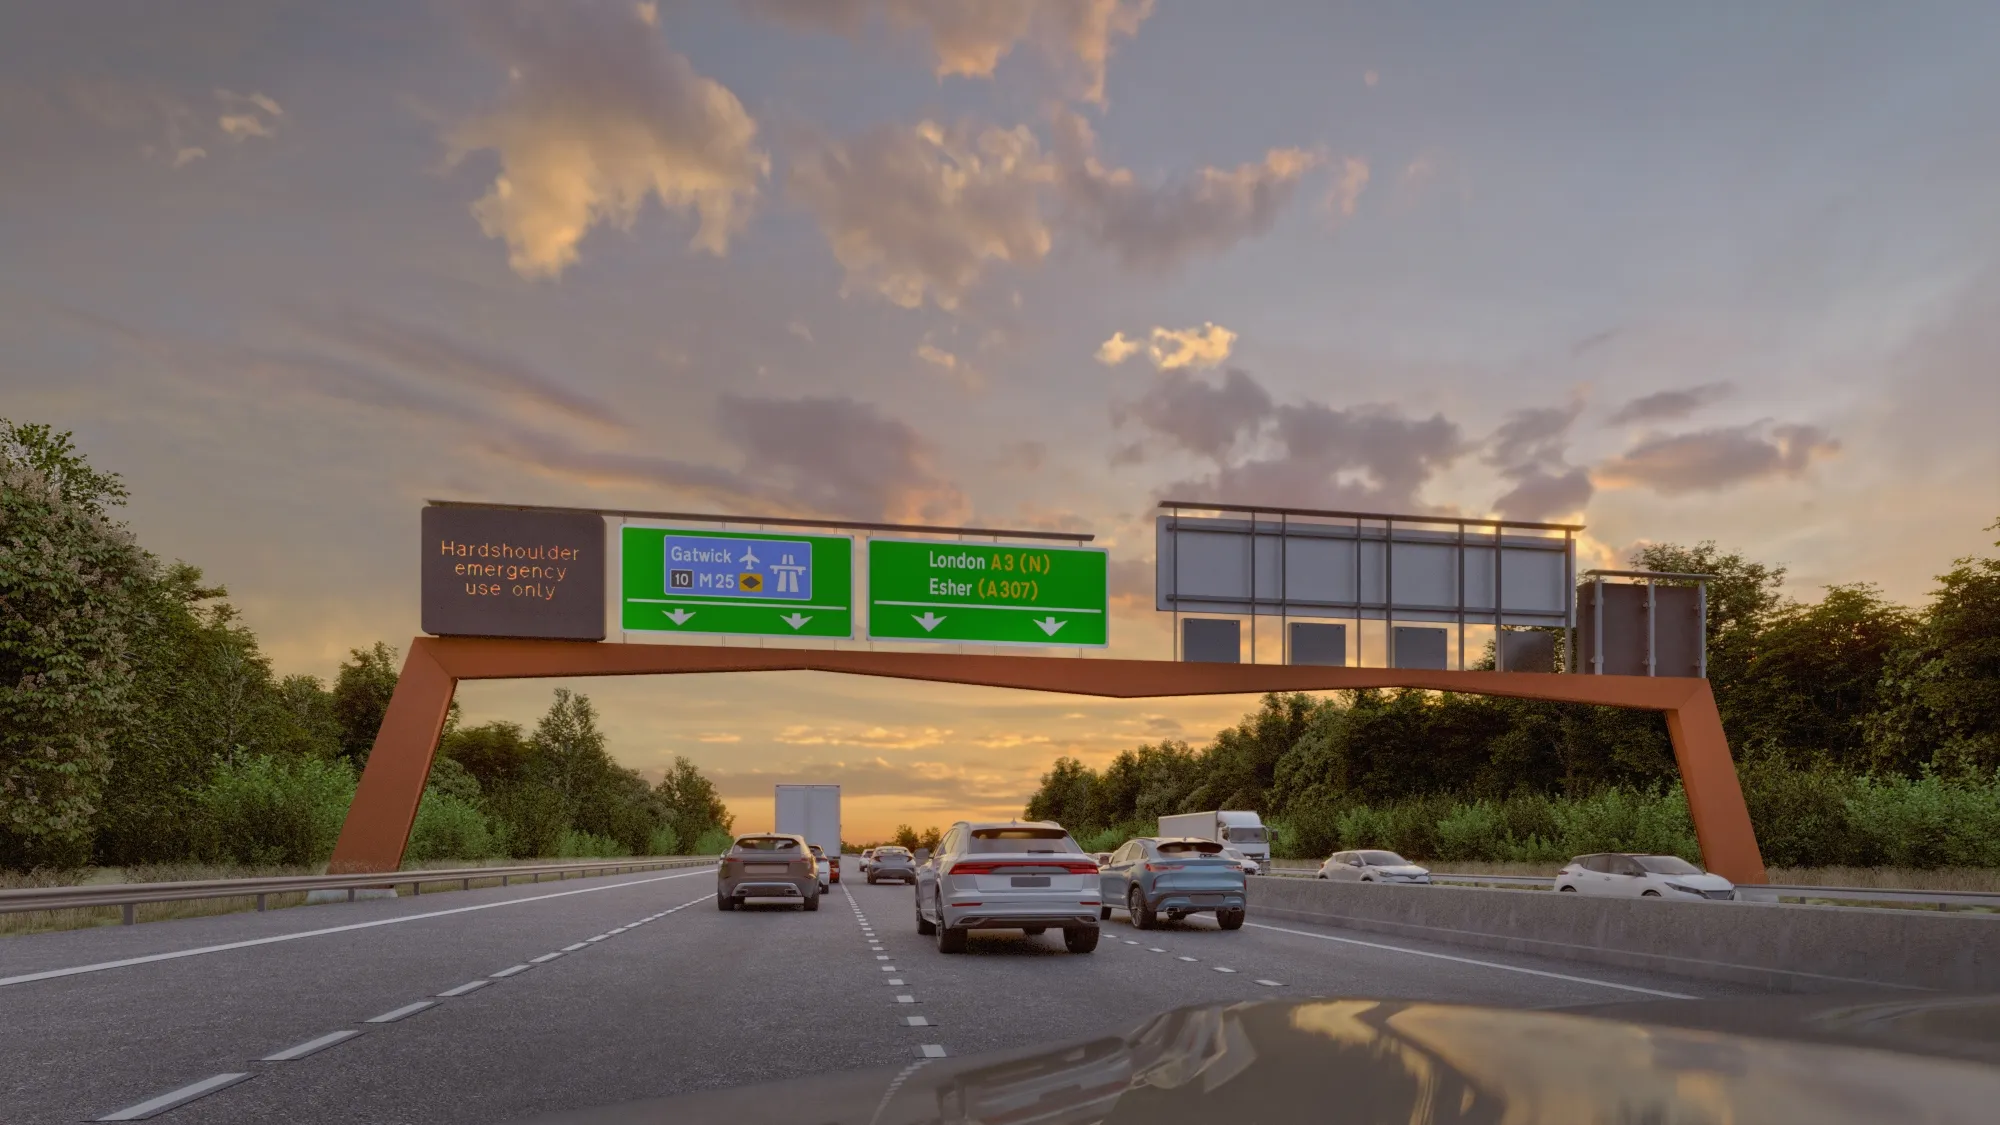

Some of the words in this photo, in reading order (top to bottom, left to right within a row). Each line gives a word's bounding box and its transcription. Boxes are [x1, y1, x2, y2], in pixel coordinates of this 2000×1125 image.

[441, 540, 579, 561] Hardshoulder
[671, 545, 732, 564] Gatwick
[455, 563, 567, 582] emergency
[929, 551, 985, 569] London
[990, 553, 1014, 572] A3
[1019, 553, 1050, 575] (N)
[674, 573, 689, 586] 10
[929, 578, 972, 596] Esher
[977, 577, 1038, 601] (A307)
[465, 582, 501, 596] use
[512, 583, 555, 600] only
